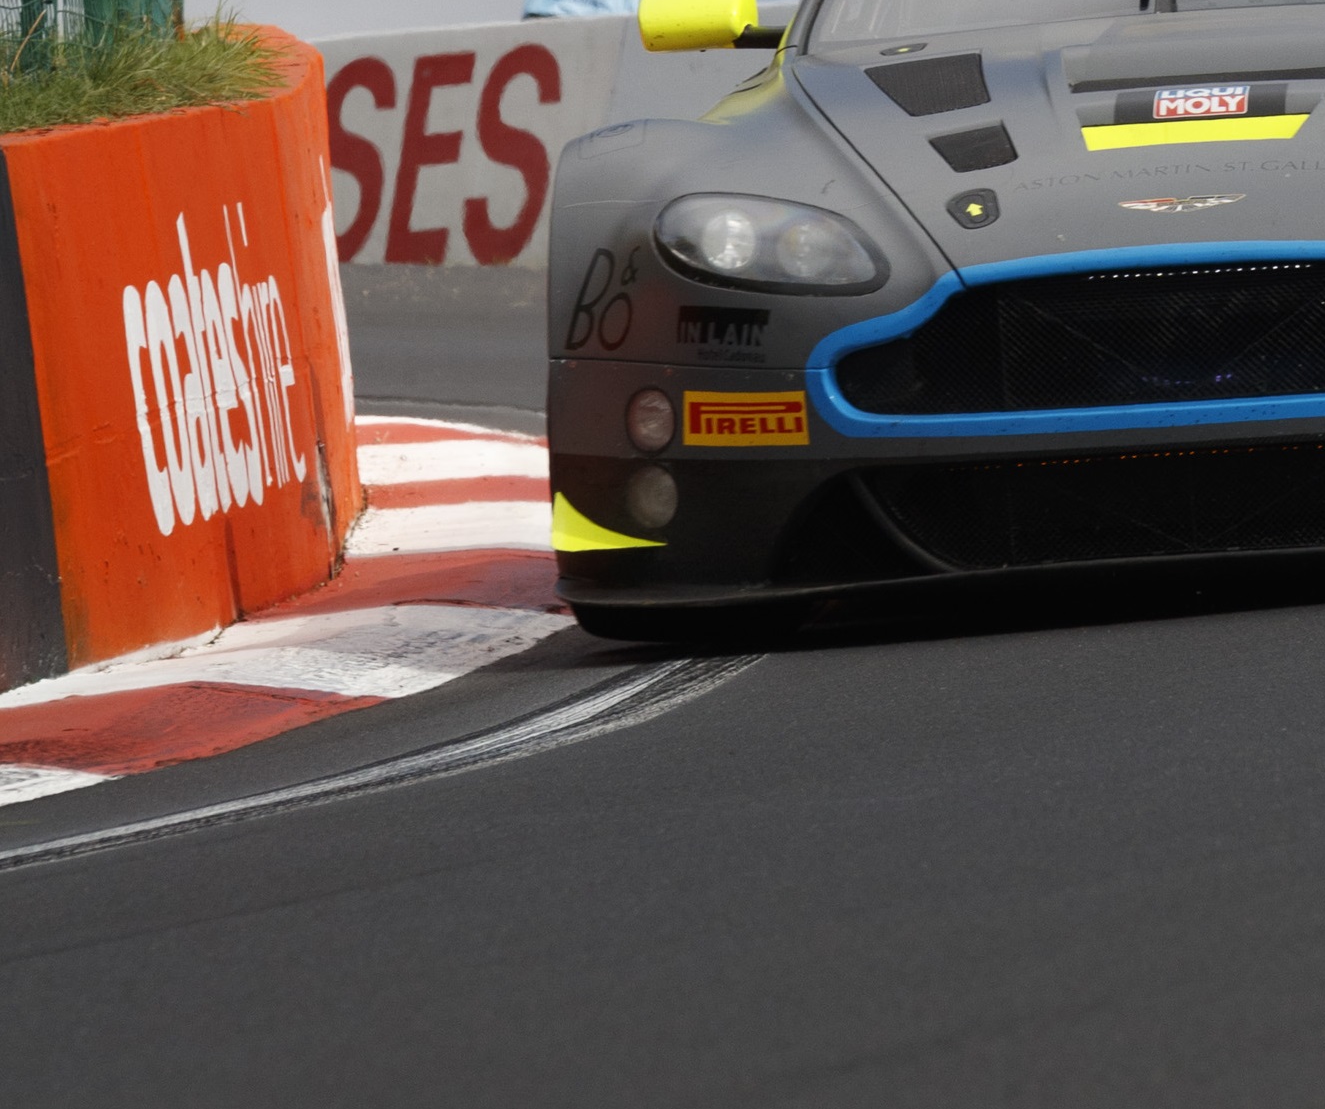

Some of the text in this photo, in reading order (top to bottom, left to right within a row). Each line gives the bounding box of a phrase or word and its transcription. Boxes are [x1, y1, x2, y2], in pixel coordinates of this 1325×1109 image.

[1160, 86, 1247, 99] LIQUI
[1159, 95, 1246, 116] MOLY
[1111, 164, 1211, 179] MARTIN
[689, 402, 803, 434] PIRELLI
